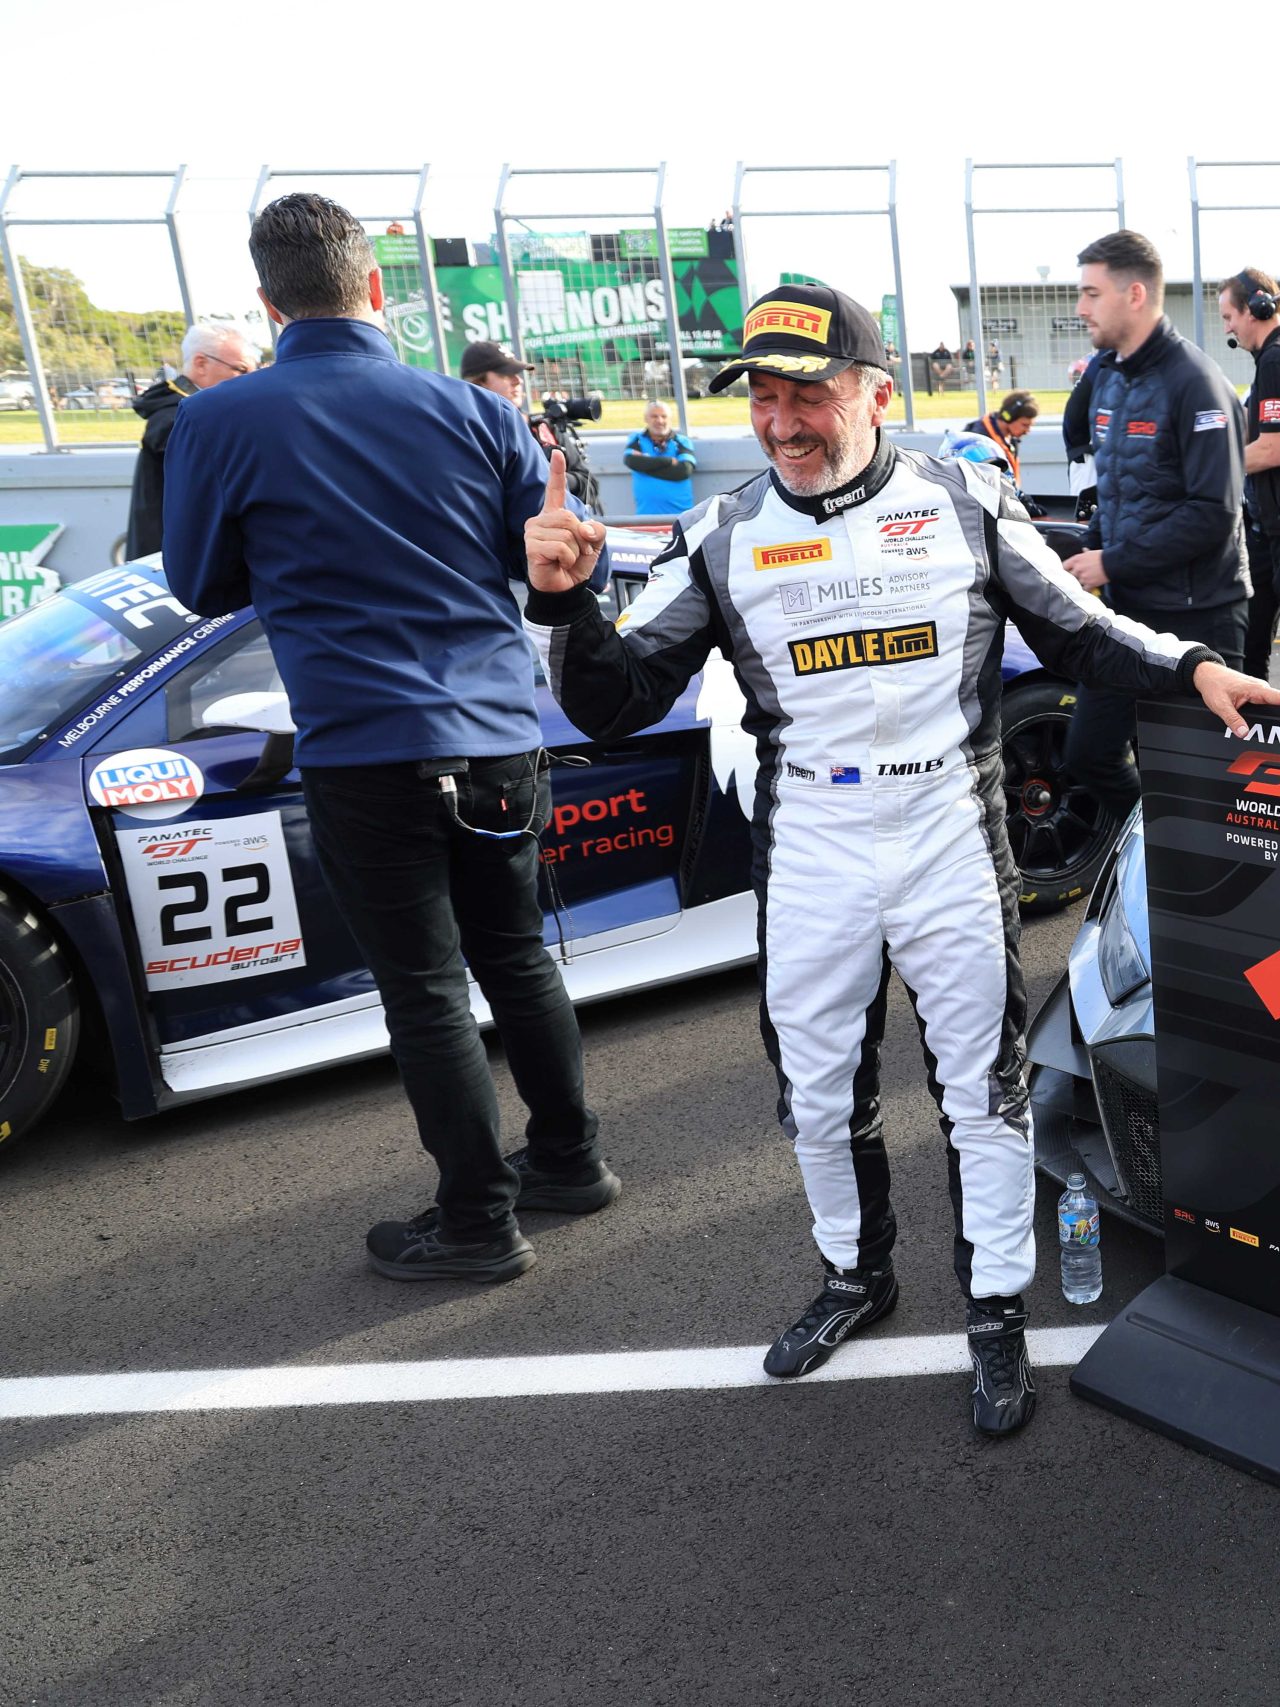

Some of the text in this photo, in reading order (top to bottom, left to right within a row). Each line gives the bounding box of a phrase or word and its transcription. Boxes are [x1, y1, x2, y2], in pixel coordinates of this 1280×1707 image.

[822, 484, 866, 514] freem
[876, 508, 939, 524] FANATEC
[761, 543, 823, 565] PIRELLI
[818, 572, 929, 603] MILES ADVISORY
[890, 583, 930, 594] PARTNERS
[793, 632, 880, 672] DAYLE
[58, 695, 122, 748] MELBOURNE
[118, 637, 196, 697] PERFORMANCE
[98, 758, 188, 788] LIQUI
[787, 761, 816, 782] freem
[876, 757, 944, 776] T.MILES
[105, 779, 191, 807] MOLY
[546, 788, 648, 835] port
[138, 828, 213, 843] FANATEC
[243, 834, 268, 846] aws
[582, 824, 675, 857] racing
[1226, 832, 1279, 851] POWERED
[1264, 851, 1279, 862] BY
[158, 862, 273, 946] 22
[145, 938, 303, 974] scuderia
[230, 952, 300, 971] autoart
[1205, 1218, 1220, 1229] aws
